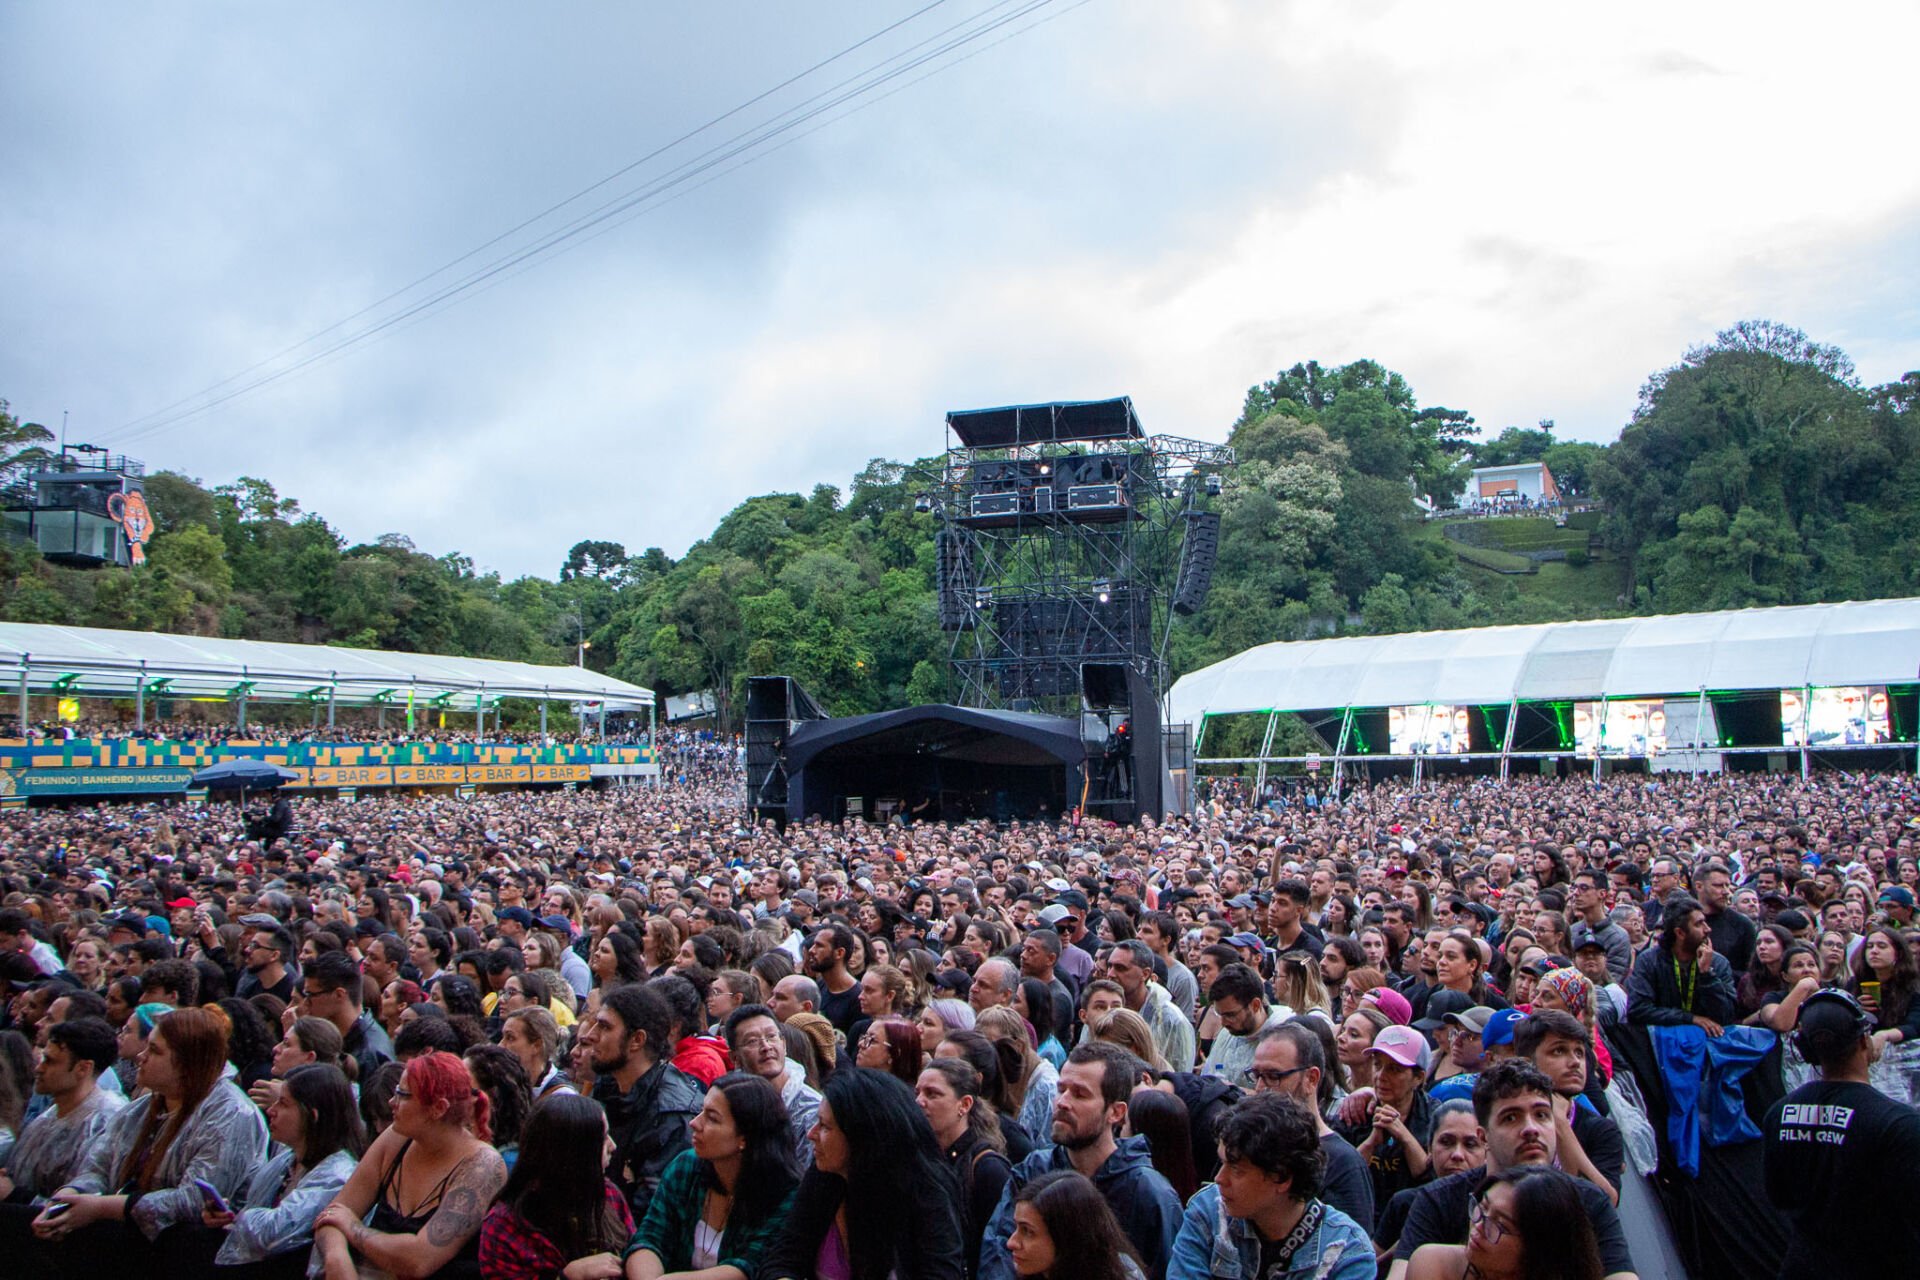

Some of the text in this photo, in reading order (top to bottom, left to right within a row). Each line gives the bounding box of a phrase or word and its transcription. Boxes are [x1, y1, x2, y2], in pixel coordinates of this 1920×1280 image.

[25, 774, 192, 785] FEMININO BANHEIRO MASCULINO
[337, 769, 370, 783] BAR
[416, 768, 446, 781] BAR
[486, 768, 513, 780] BAR
[550, 767, 575, 779] BAR
[1779, 1129, 1846, 1145] FILM CREW
[1279, 1204, 1321, 1258] adidas
